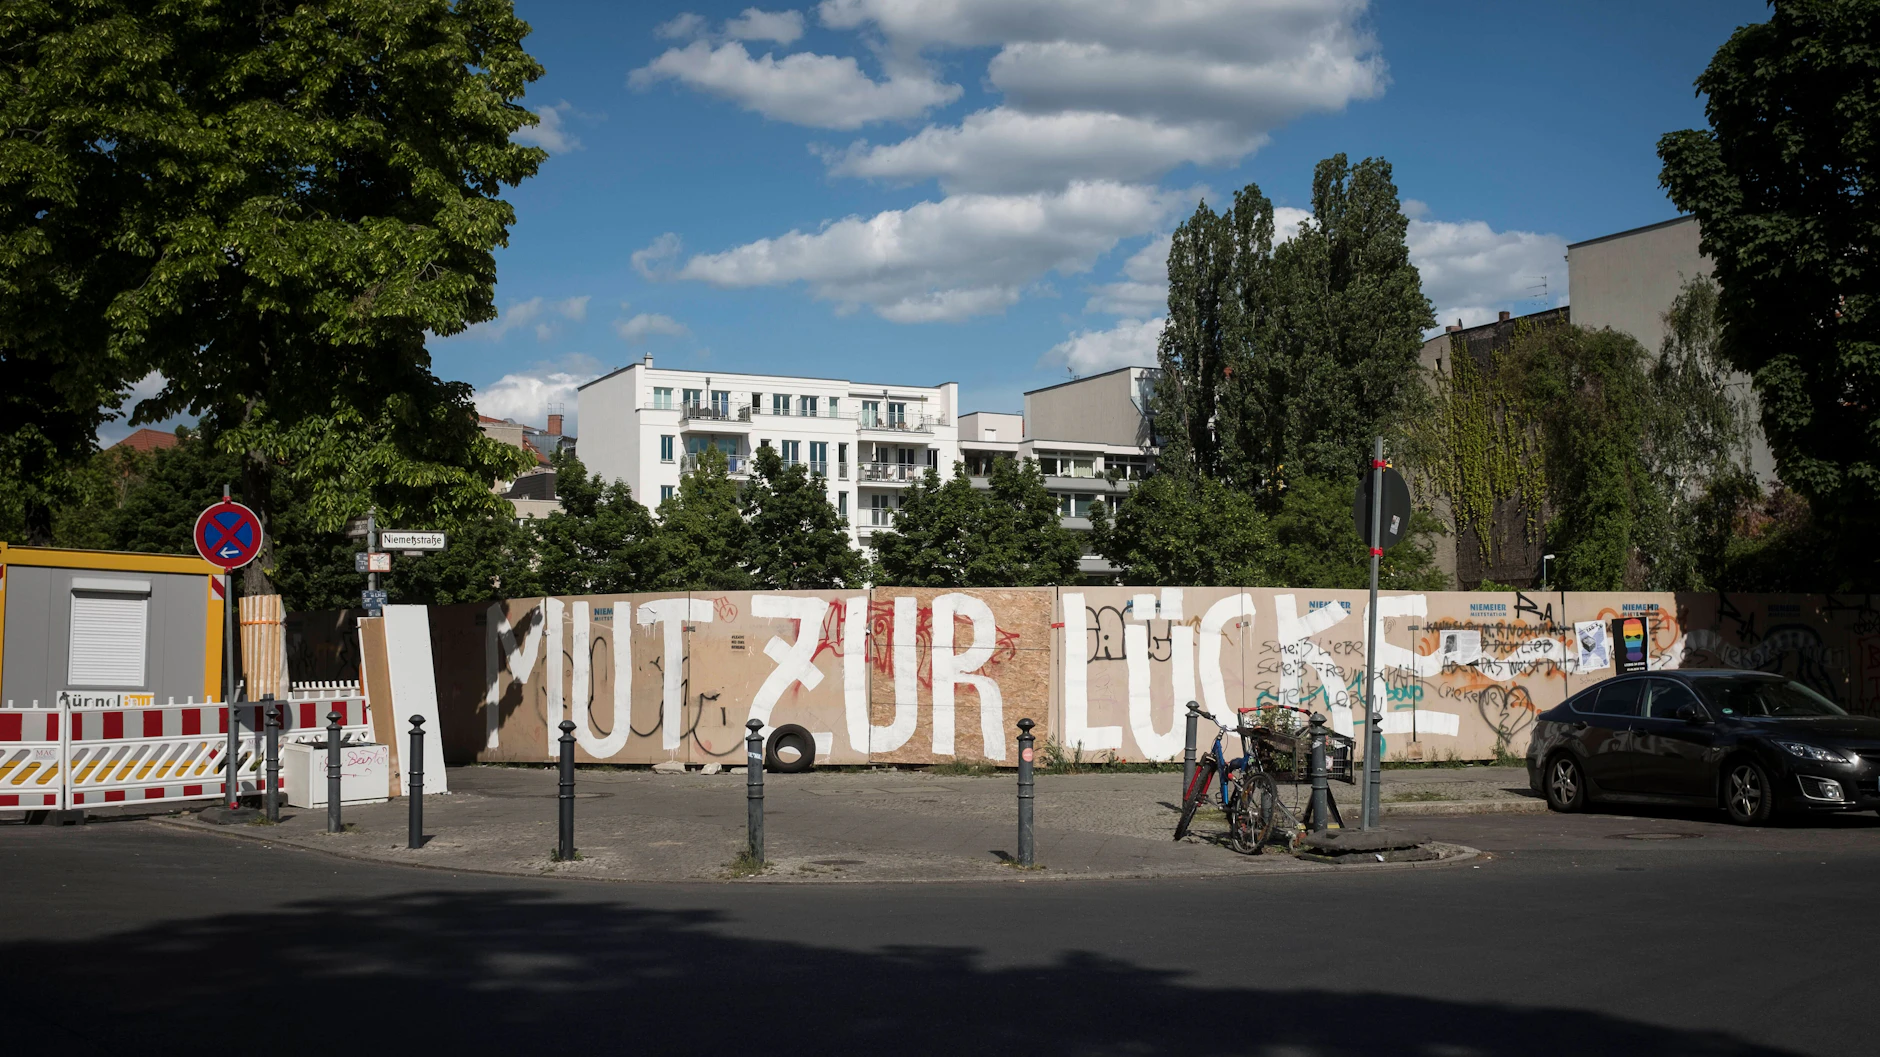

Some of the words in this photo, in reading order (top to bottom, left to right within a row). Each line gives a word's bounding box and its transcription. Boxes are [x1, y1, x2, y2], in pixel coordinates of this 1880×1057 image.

[1309, 601, 1351, 609] NIEER
[1470, 603, 1507, 611] NIEMEIER
[486, 597, 713, 759] MUT
[745, 593, 1006, 760] ZUR
[1062, 587, 1459, 761] LÜCKE
